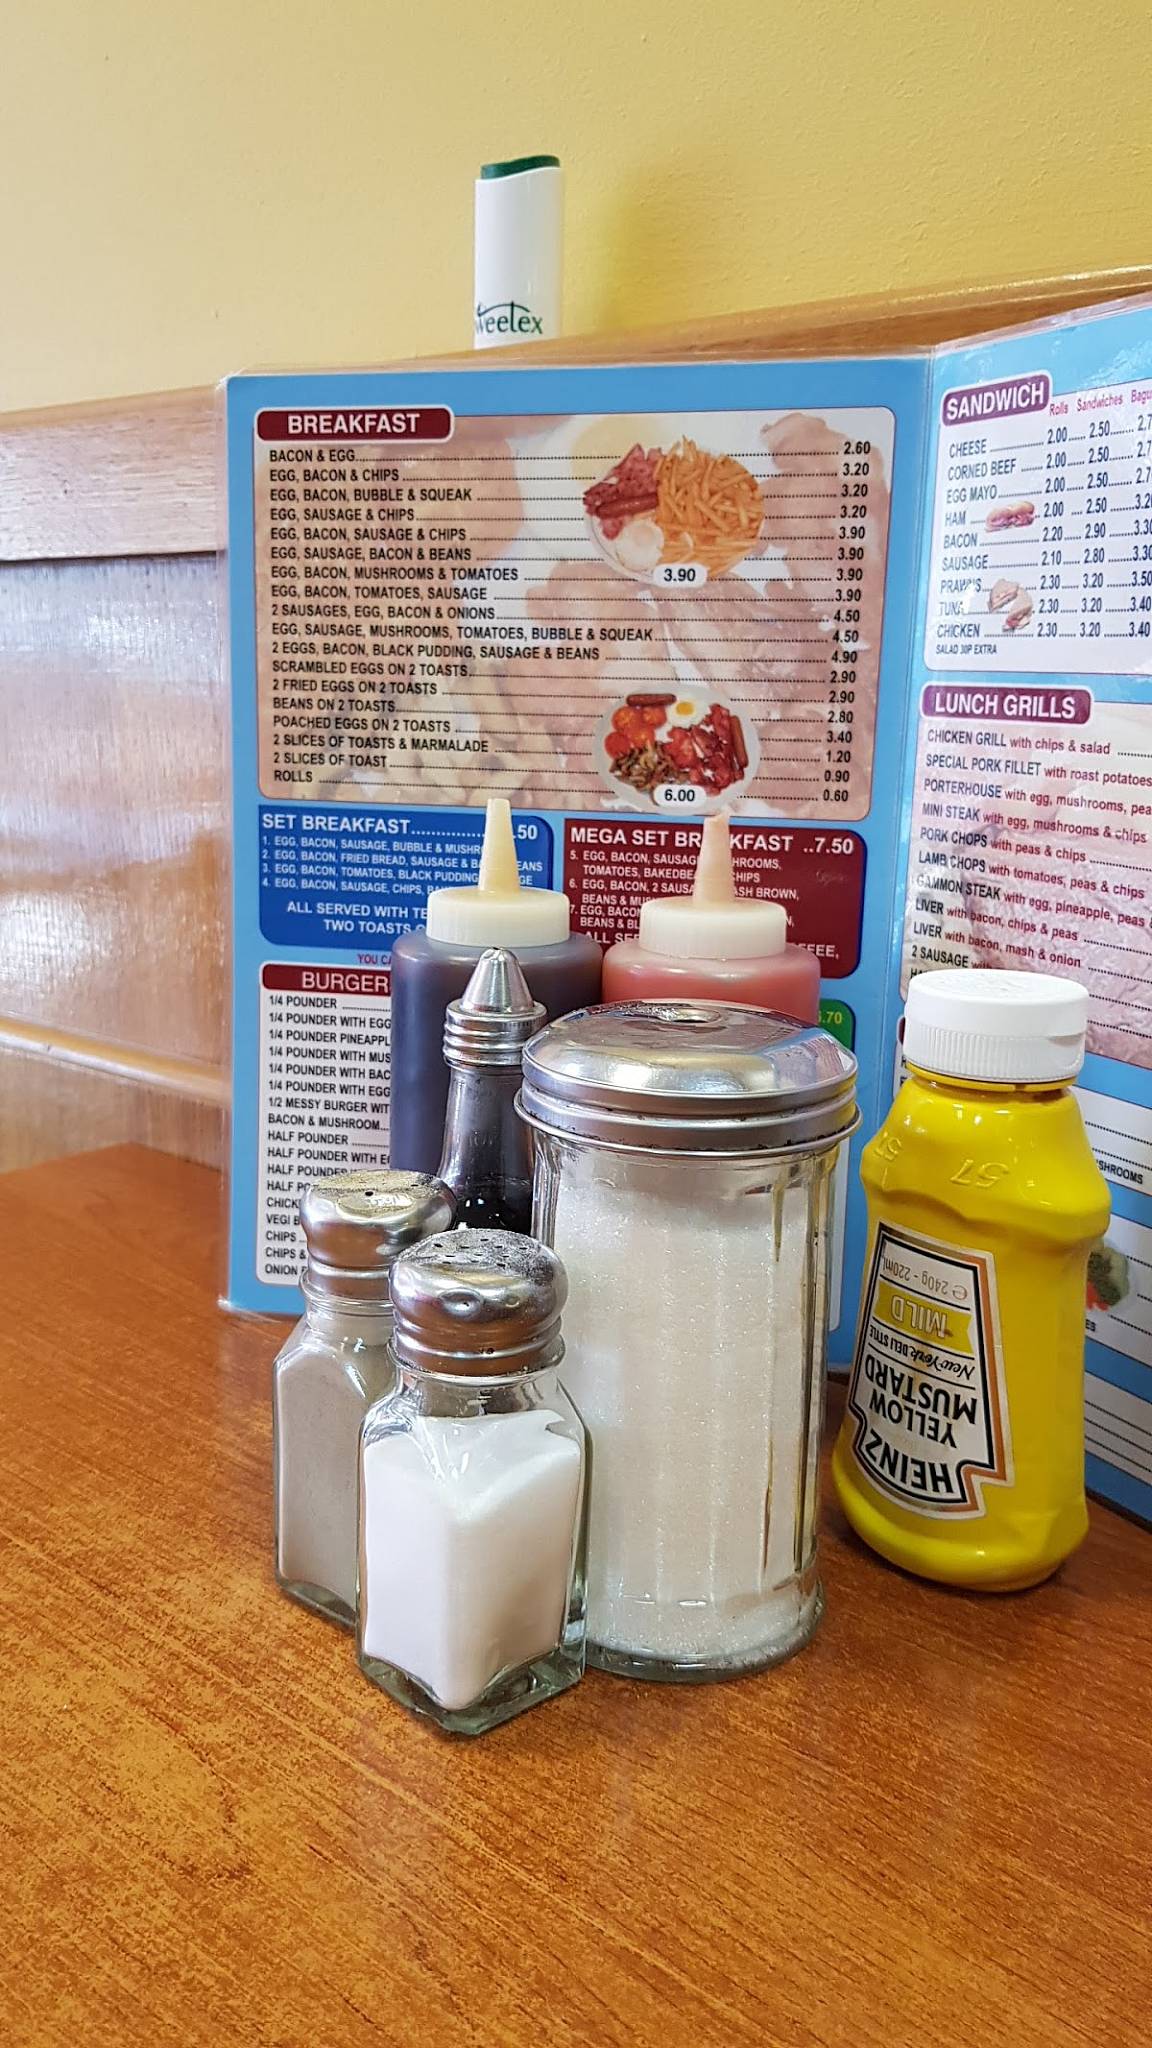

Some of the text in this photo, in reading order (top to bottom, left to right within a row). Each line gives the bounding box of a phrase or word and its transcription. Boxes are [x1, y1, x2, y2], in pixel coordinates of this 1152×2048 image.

[947, 382, 1045, 419] SANDWICH
[1050, 396, 1123, 416] Rolls Sandwiches
[288, 413, 420, 433] BREAKFAST
[949, 420, 1110, 458] CHEESE 2.00 2.50
[270, 442, 870, 461] BACON & EGG 2.60
[270, 463, 869, 482] EGG, BACON & CHIPS 3.20
[948, 446, 1109, 480] CORNED BEEF 2.00 2.50
[270, 484, 867, 502] EGG, BACON, BUBBLE & SQUEAK 3.20
[947, 472, 1108, 503] EGG MAYO 2.00 2.50
[944, 523, 1105, 549] BACON 2.20 2.90
[271, 548, 864, 561] EGG, SAUSAGE, BACON & BEANS 3.90
[942, 549, 1104, 571] SAUSAGE 2.10 2.80
[272, 567, 863, 581] EGG, BACON, MUSHROOMS & TOMATOES 3.90
[663, 569, 695, 582] 3.90
[273, 623, 859, 643] EGG, SAUSAGE, MUSHROOMS, TOMATOES, BUBBLE & SQUEAK 4.50
[937, 622, 1150, 638] CHICKEN 2.30 3.20 3.40
[273, 642, 858, 664] 2 EGGS, BACON, BLACK PUDDING, SAUSAGE & BEANS 4.90
[936, 644, 958, 654] SALAD
[974, 644, 997, 654] EXTRA
[935, 693, 1075, 719] LUNCH GRILLS
[928, 729, 1110, 755] CHICKEN GRILL with chips & salad
[926, 754, 1099, 782] SPECIAL PORK FILLET with roast
[274, 770, 849, 802] ROLLS 0.60
[664, 789, 695, 801] 6.00
[262, 814, 410, 834] SET BREAKFAST
[263, 836, 442, 852] 1. EGG, BACON, SAUSAGE, BUBBLE &
[571, 827, 626, 844] MEGA
[632, 829, 668, 846] SET
[675, 835, 794, 852] BRKFAST
[920, 827, 1086, 862] PORK CHOPS with peas & chips
[584, 865, 640, 877] TOMATOES,
[756, 888, 799, 901] BROWN,
[287, 901, 409, 918] ALL SERVED WITH
[324, 920, 411, 934] TWO TOASTS
[357, 954, 378, 964] YOU
[302, 971, 391, 993] BURGER
[269, 995, 337, 1008] 1/4 POUNDER
[269, 1013, 283, 1022] 1/4
[287, 1013, 337, 1025] POUNDER
[341, 1016, 366, 1027] WITH
[269, 1097, 367, 1112] 1/2 MESSY BURGER
[268, 1114, 380, 1129] BACON & MUSHROOM
[268, 1132, 348, 1145] HALF POUNDER
[950, 1157, 1009, 1189] 57
[1096, 1159, 1144, 1184] SHROOMS
[266, 1214, 290, 1224] VEGI
[266, 1231, 296, 1242] CHIPS
[265, 1264, 298, 1275] ONION
[883, 1258, 911, 1281] 220ml
[922, 1271, 948, 1295] 240g
[891, 1295, 948, 1338] MILD
[870, 1325, 889, 1346] STYLE
[890, 1338, 908, 1356] DELI
[940, 1359, 975, 1380] New
[865, 1353, 978, 1425] MUSTARD
[869, 1389, 957, 1449] YELLOW
[865, 1432, 954, 1494] HEINZ
